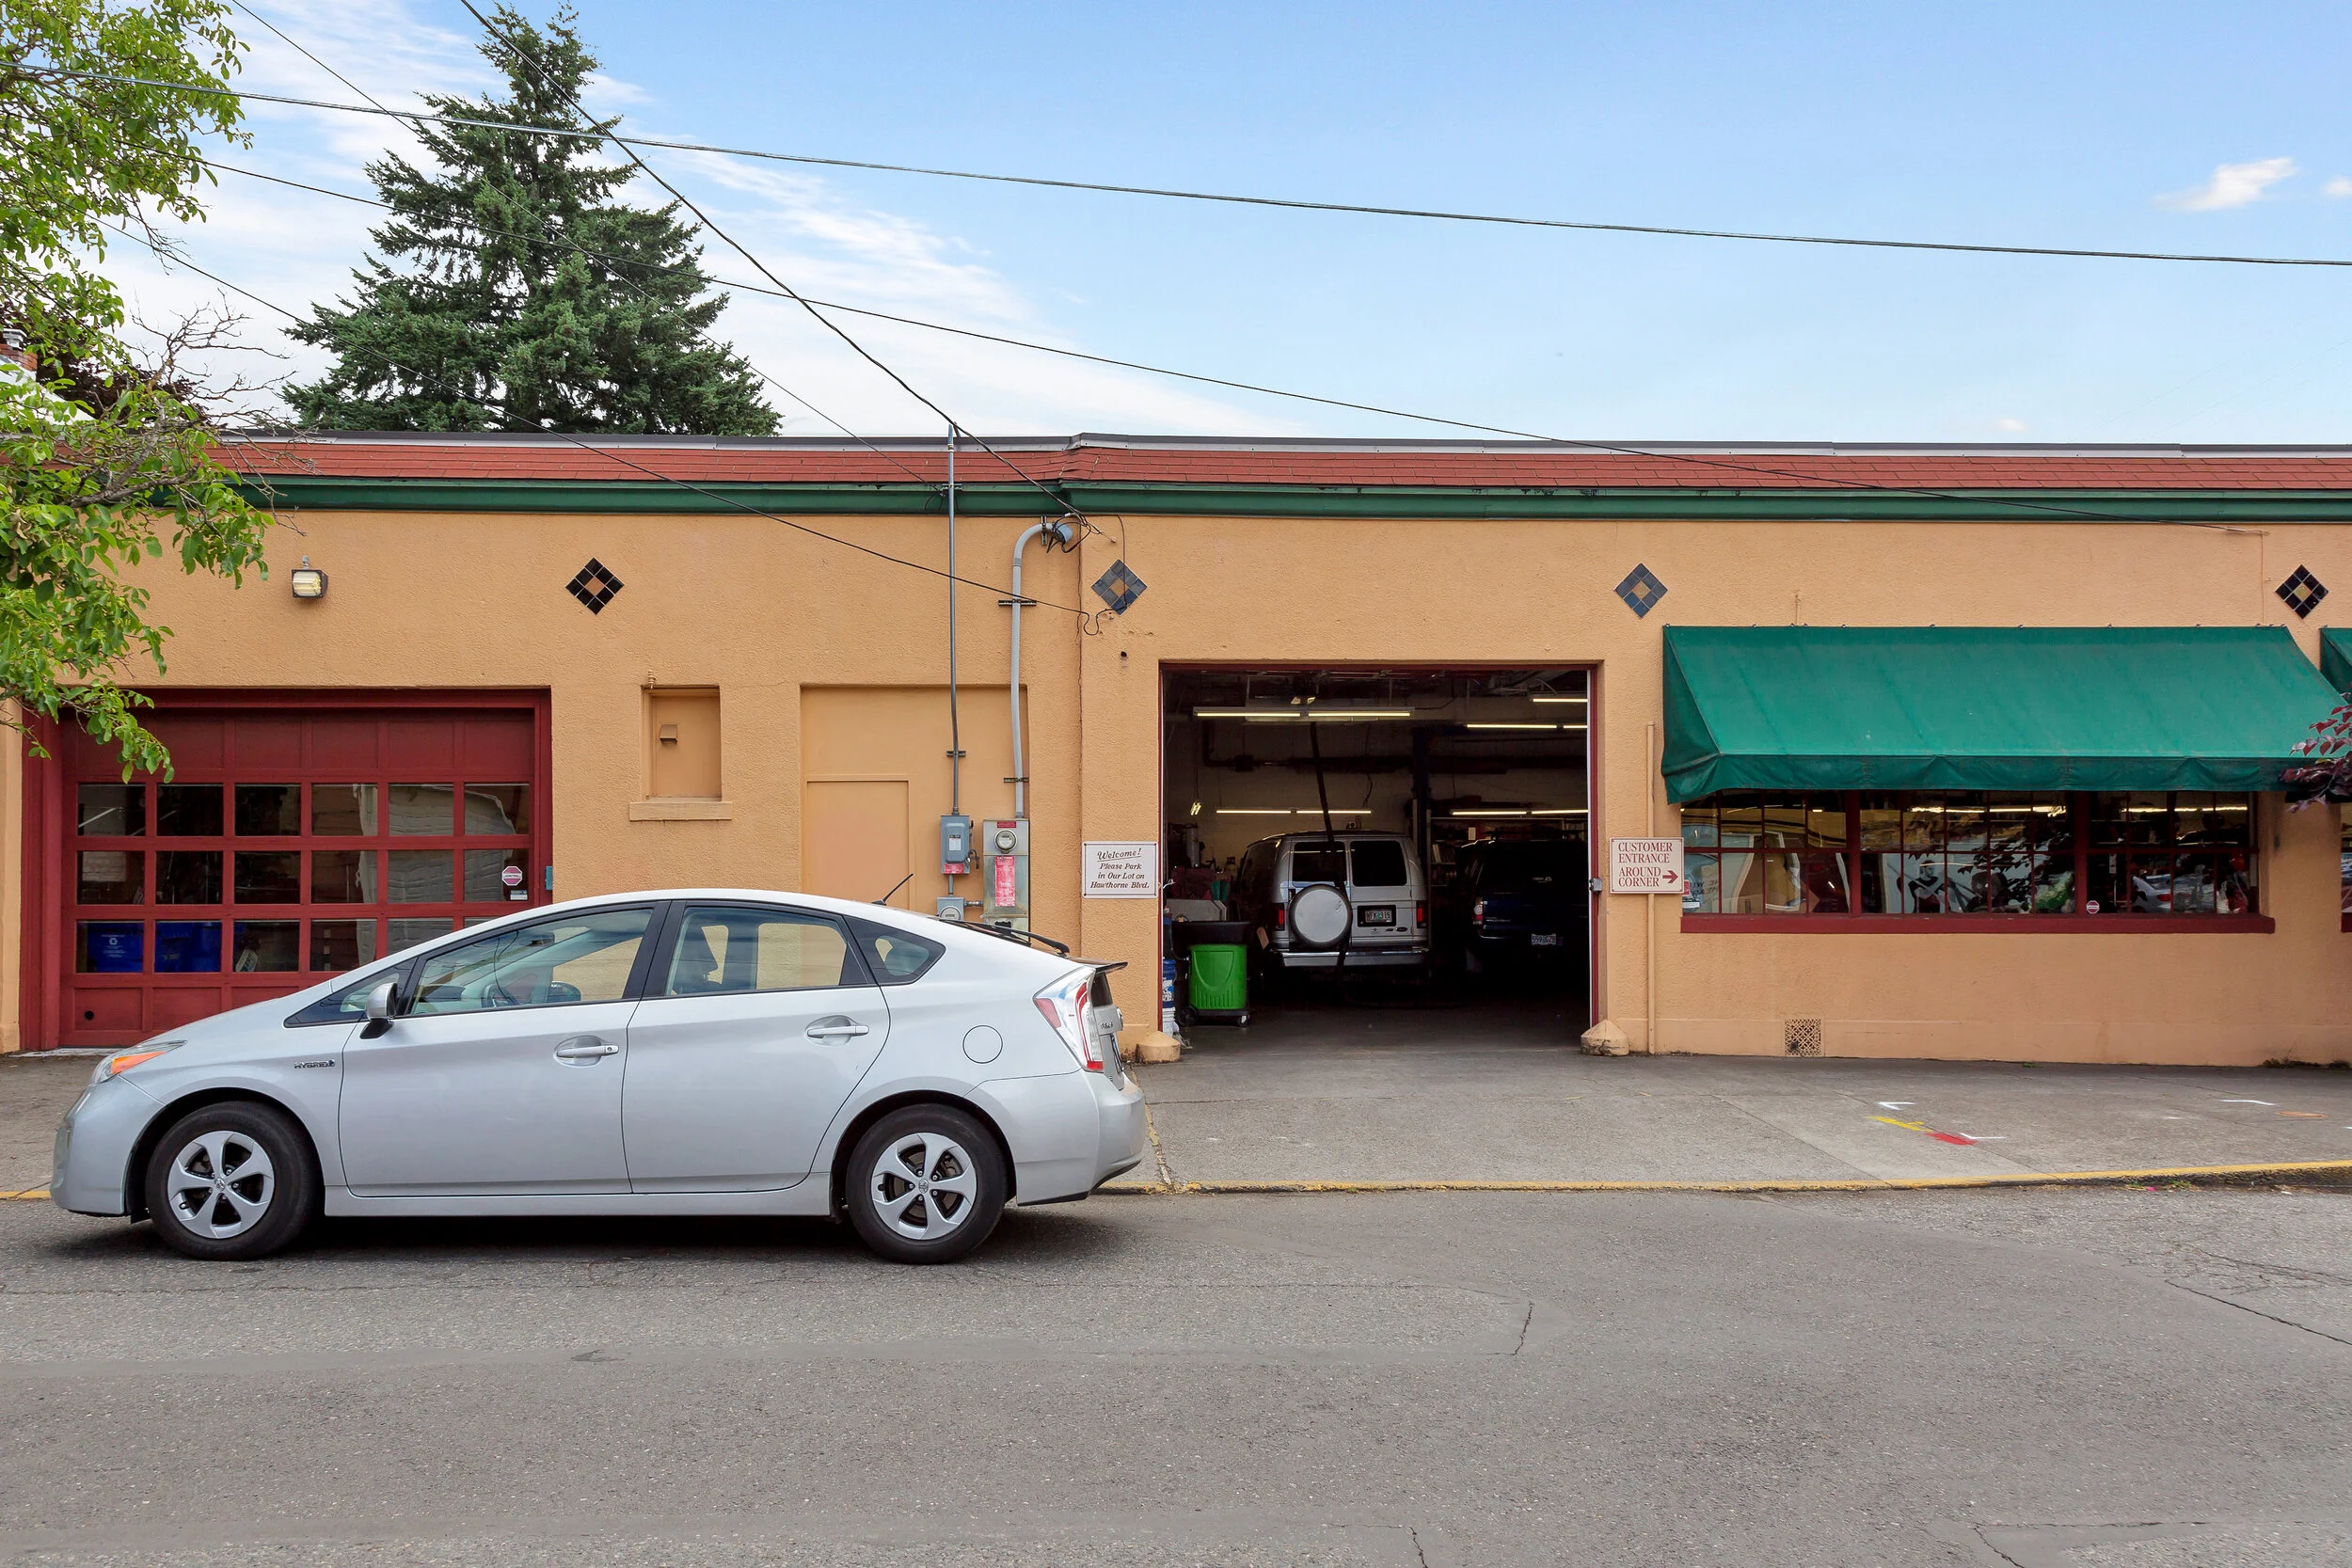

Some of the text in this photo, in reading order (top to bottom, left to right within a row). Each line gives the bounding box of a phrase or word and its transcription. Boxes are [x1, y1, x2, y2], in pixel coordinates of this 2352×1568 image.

[1618, 842, 1673, 852] CUSTOMER
[1097, 847, 1142, 861] Welcome!
[1618, 853, 1670, 863] ENTRANCE
[1618, 866, 1661, 877] AROUND
[1618, 877, 1660, 887] CORNER
